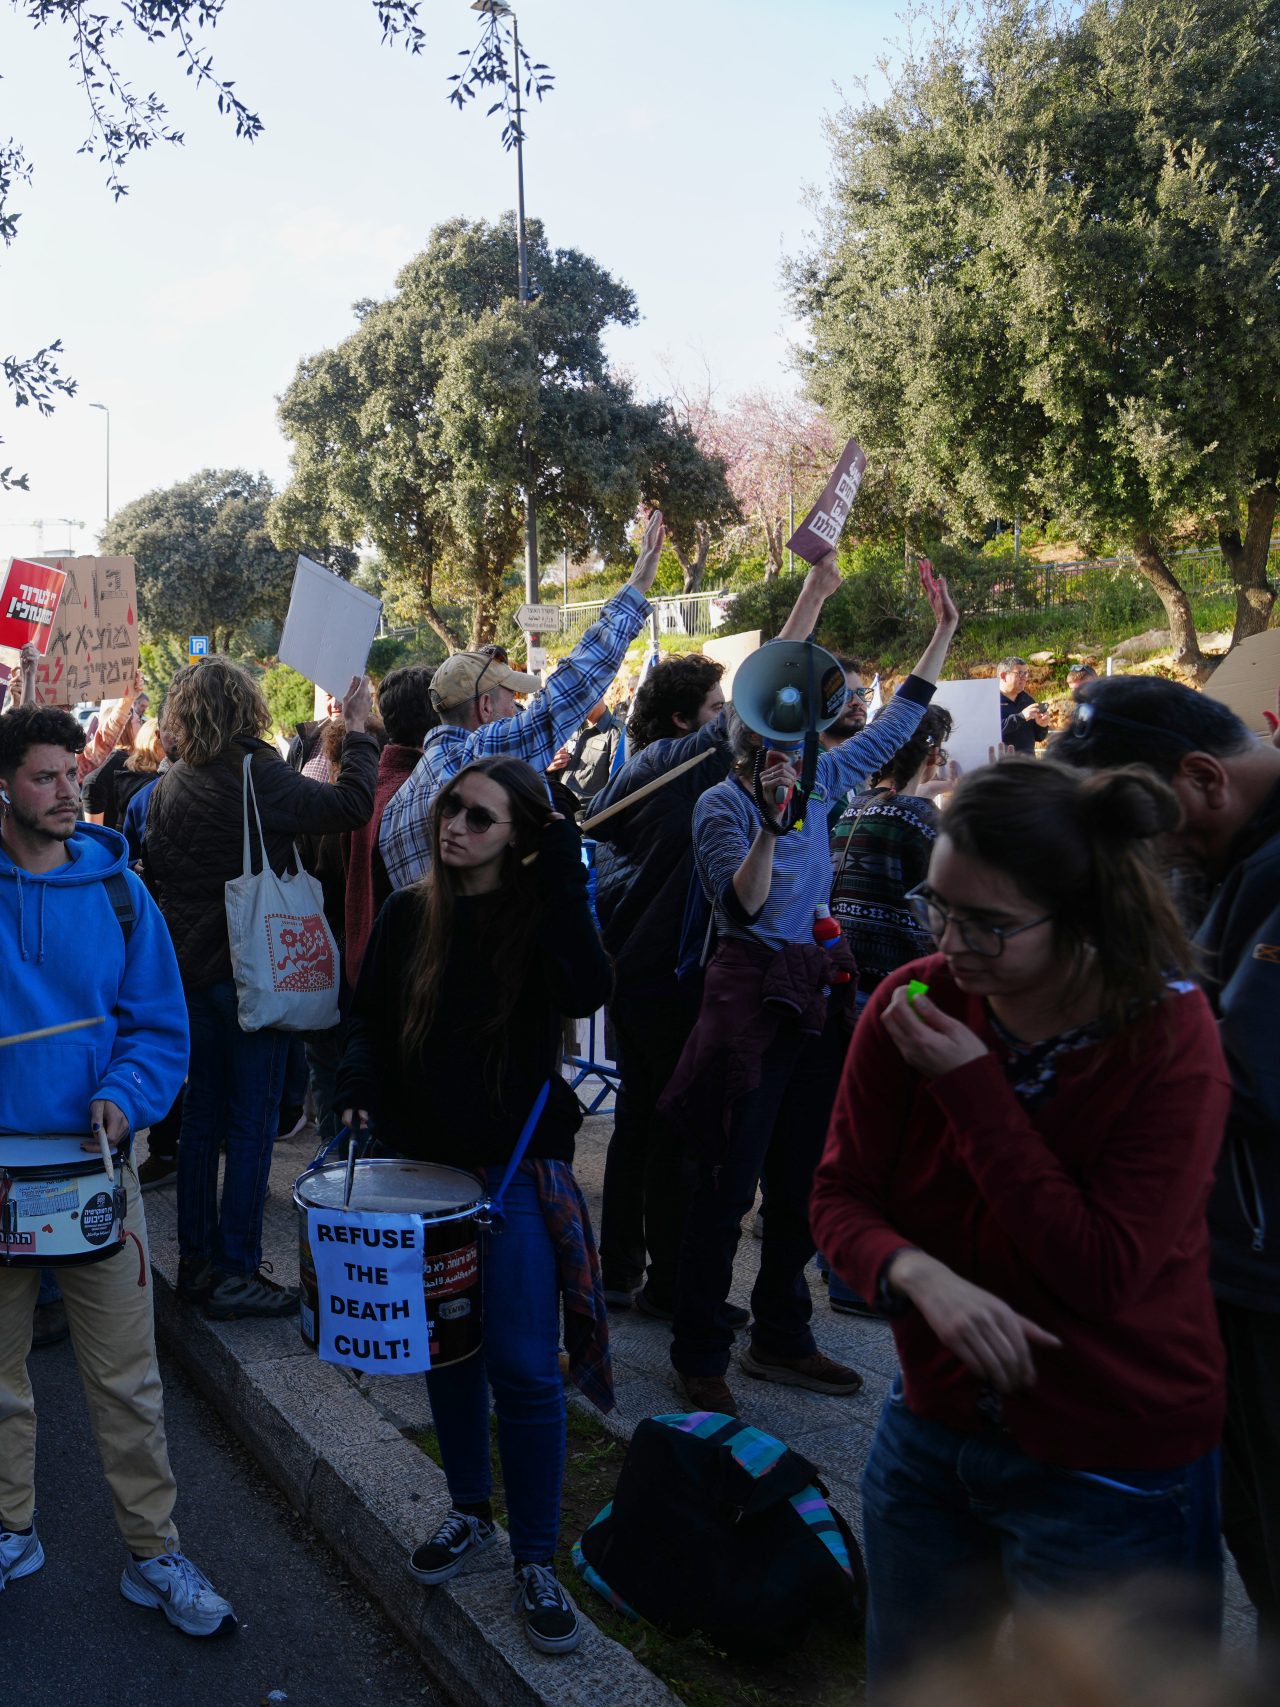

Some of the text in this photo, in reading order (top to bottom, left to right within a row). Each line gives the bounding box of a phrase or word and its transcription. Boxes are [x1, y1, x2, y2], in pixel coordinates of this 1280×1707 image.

[19, 583, 51, 606] לטרור
[84, 1215, 104, 1224] כיבוש
[317, 1224, 416, 1249] REFUSE
[344, 1262, 389, 1286] THE
[330, 1295, 410, 1322] DEATH
[334, 1335, 411, 1361] CULT!
